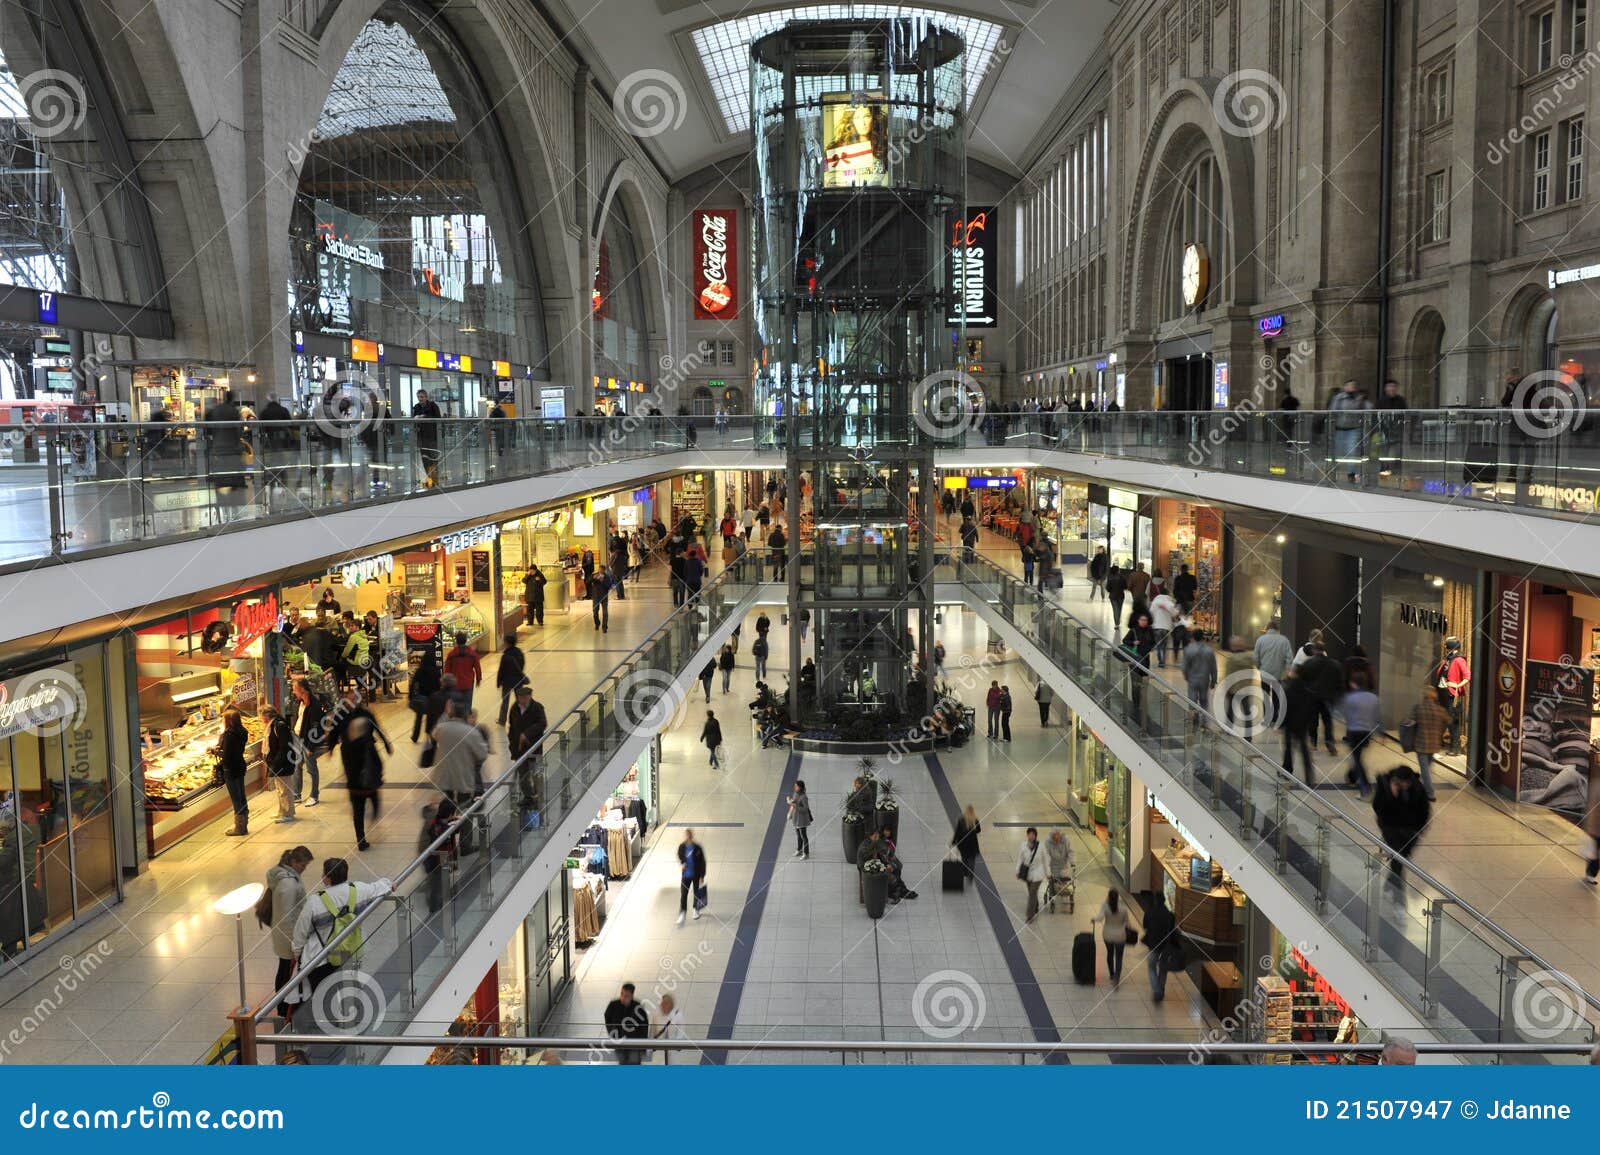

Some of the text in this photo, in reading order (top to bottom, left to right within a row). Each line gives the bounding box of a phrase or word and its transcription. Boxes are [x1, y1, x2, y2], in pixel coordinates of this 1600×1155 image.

[325, 233, 385, 269] Sachsen Bank
[966, 247, 984, 313] SATURN
[40, 292, 52, 311] 17
[1260, 315, 1282, 330] COSMO
